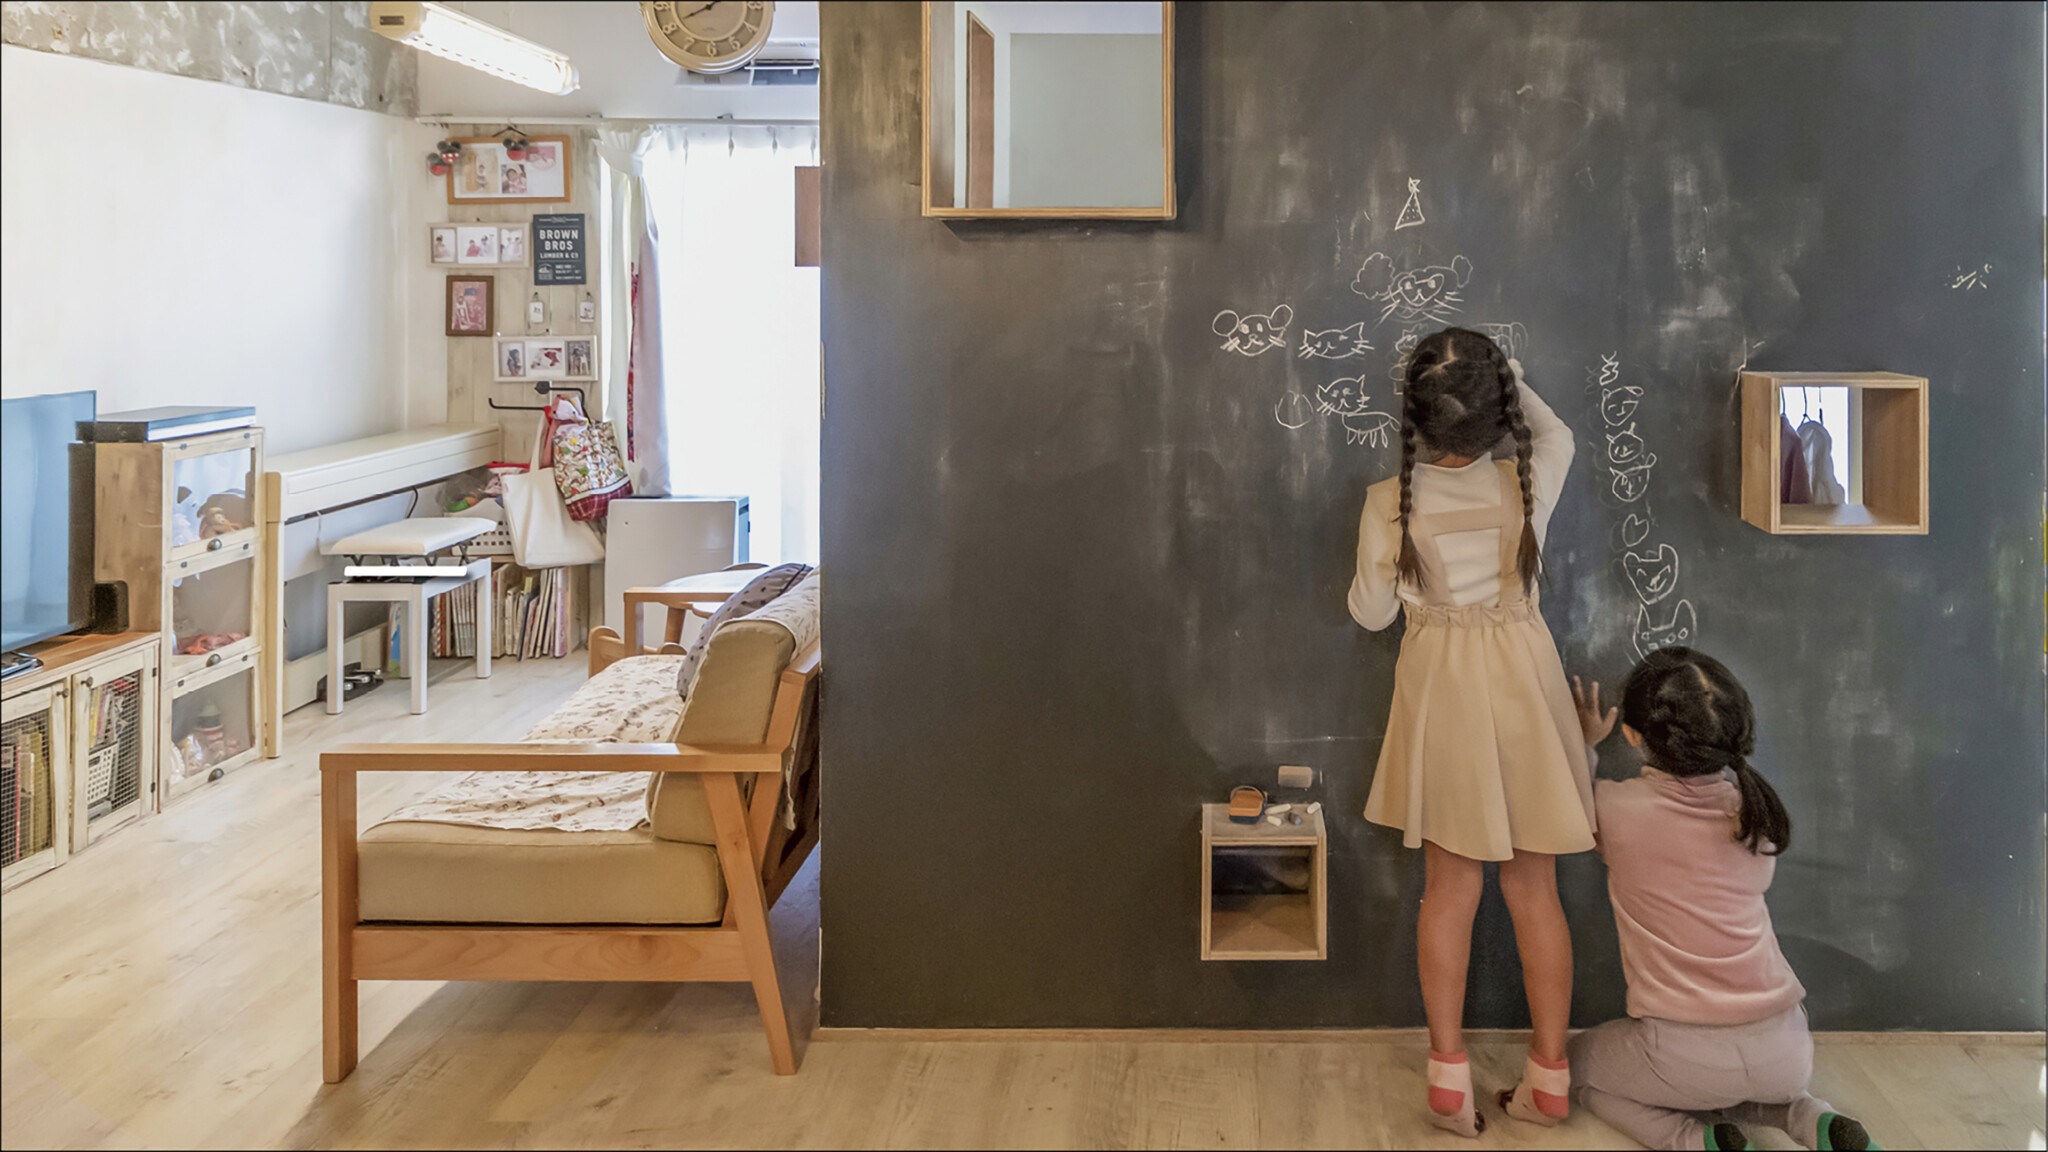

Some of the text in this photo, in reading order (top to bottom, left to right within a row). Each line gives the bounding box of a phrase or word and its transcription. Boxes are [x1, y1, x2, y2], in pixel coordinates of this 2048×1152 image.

[662, 22, 677, 35] 8
[743, 20, 759, 33] 4
[683, 36, 695, 51] 7
[706, 40, 718, 57] 6
[728, 36, 741, 50] 5
[539, 229, 579, 240] BROWN
[544, 240, 574, 251] BROS
